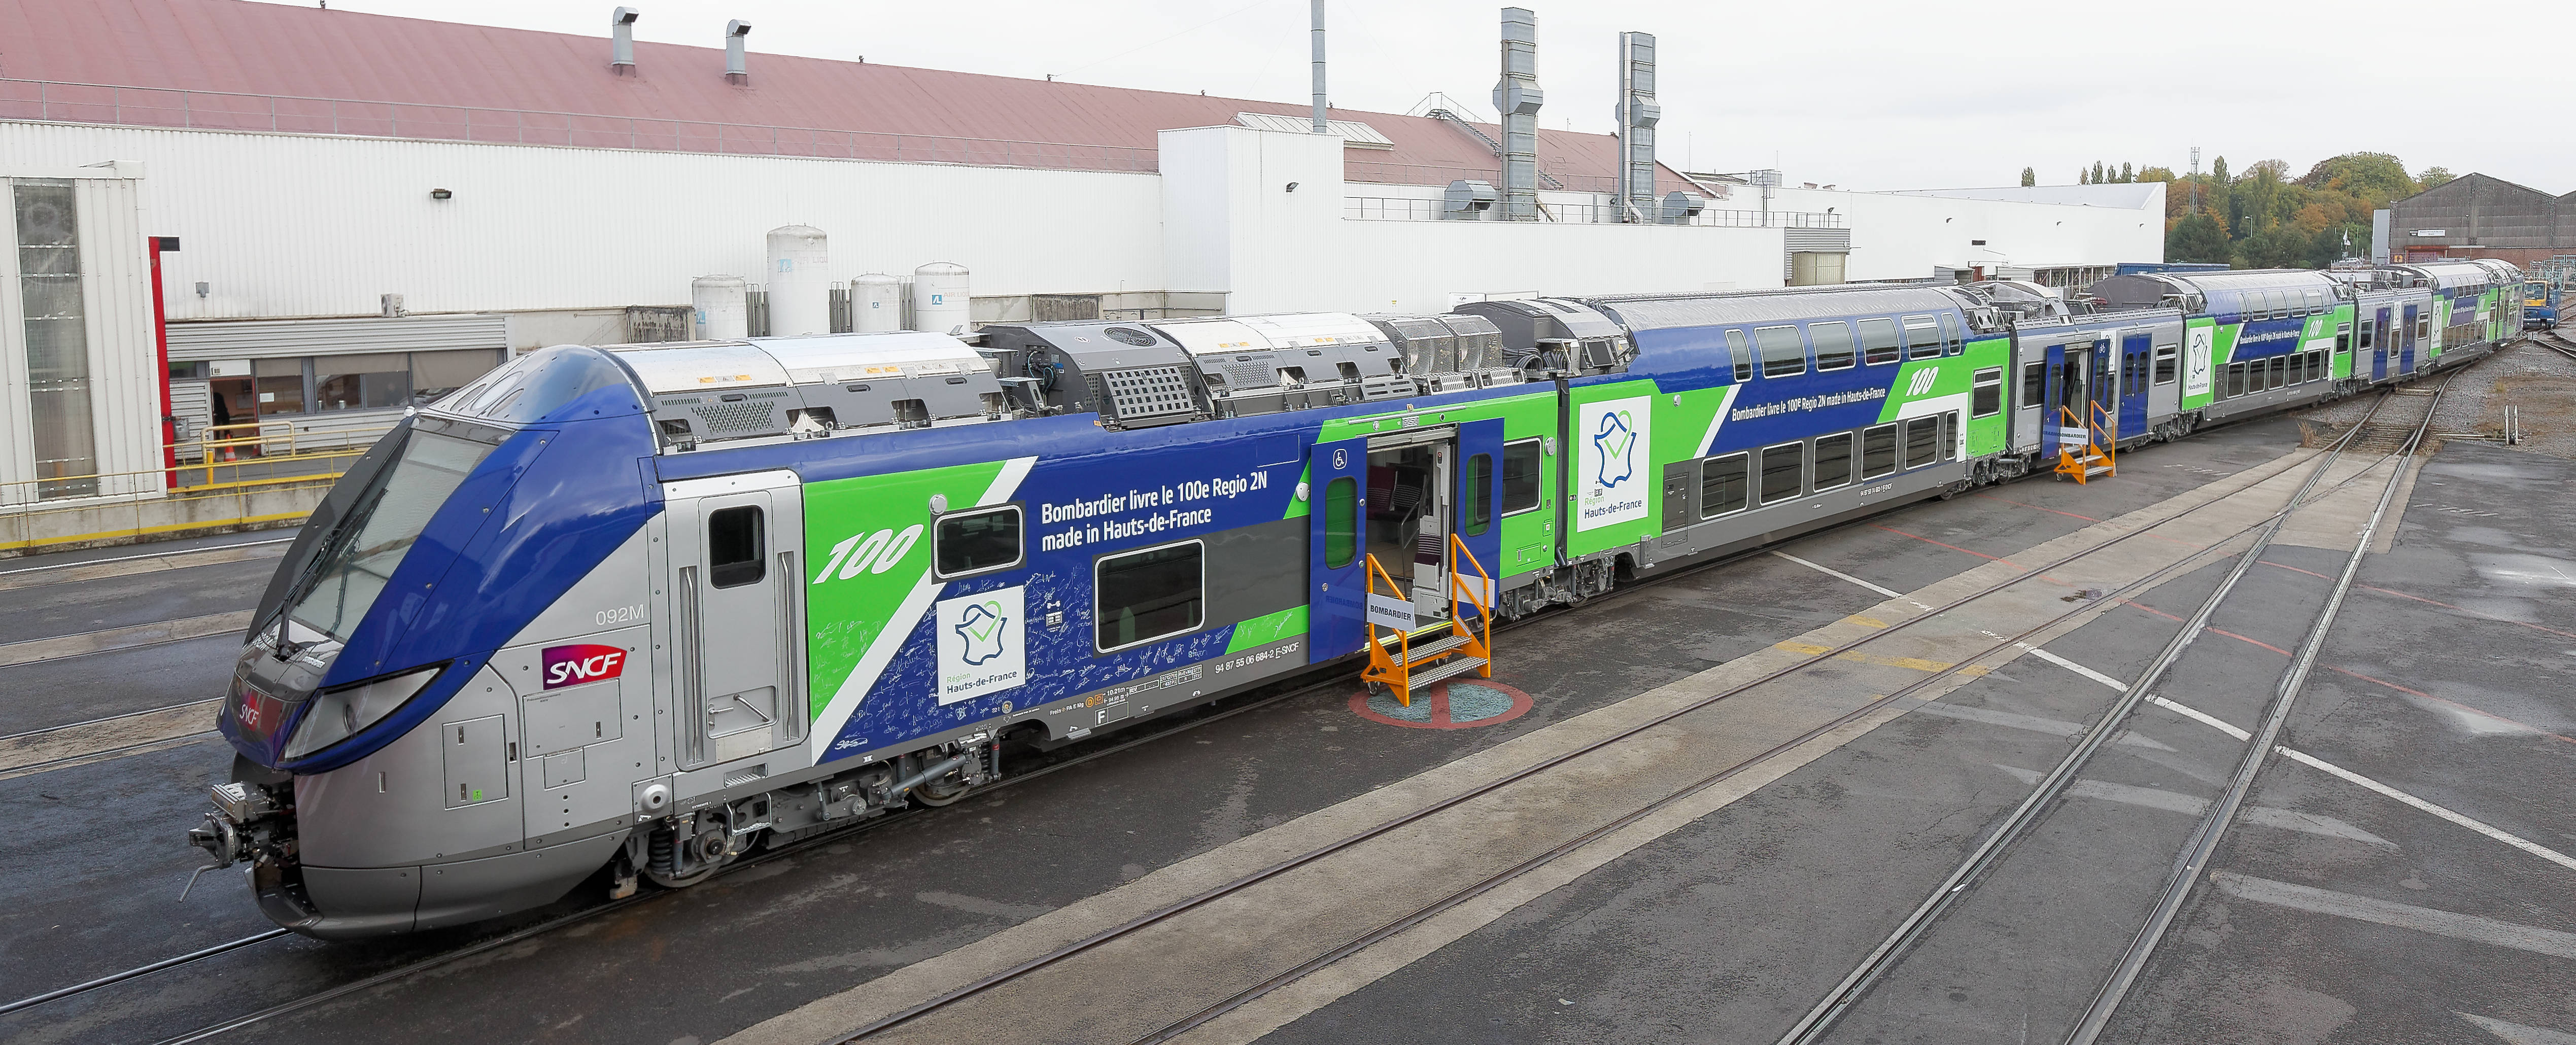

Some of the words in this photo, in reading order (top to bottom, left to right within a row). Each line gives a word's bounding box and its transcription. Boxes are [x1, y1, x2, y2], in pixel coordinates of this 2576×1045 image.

[1905, 366, 1939, 397] 100
[1732, 406, 1766, 422] Bombardier
[1767, 402, 1779, 416] livre
[1780, 401, 1786, 413] le
[1802, 397, 1817, 412] Regio
[1818, 396, 1826, 408] 2N
[1827, 395, 1841, 406] made
[1841, 393, 1847, 403] in
[1847, 387, 1886, 402] Hauts-de-France
[1042, 494, 1126, 525] Bombardier
[1129, 489, 1157, 510] livre
[1161, 484, 1174, 505] le
[1177, 480, 1210, 503] 100e
[1213, 475, 1246, 499] Regio
[1250, 470, 1267, 491] 2N
[1585, 496, 1604, 506] Région
[1584, 500, 1642, 519] Hauts-de-France
[1042, 529, 1083, 552] made
[1086, 525, 1099, 543] in
[1103, 508, 1212, 541] Hauts-de-France
[812, 524, 924, 585] 100
[596, 604, 644, 626] 092M
[1370, 605, 1412, 621] BOMBARDIER
[546, 652, 621, 684] SNCF
[1215, 664, 1224, 674] 94
[1225, 660, 1234, 671] 87
[1235, 658, 1245, 668] 55
[1246, 655, 1254, 665] 06
[1255, 649, 1274, 662] 684-2
[1275, 642, 1299, 659] F-SNCF
[947, 673, 971, 683] Région
[947, 671, 1017, 694] Hauts-de-France
[1107, 687, 1125, 696] 10.21m
[239, 704, 260, 725] SNCF
[1097, 710, 1106, 724] F
